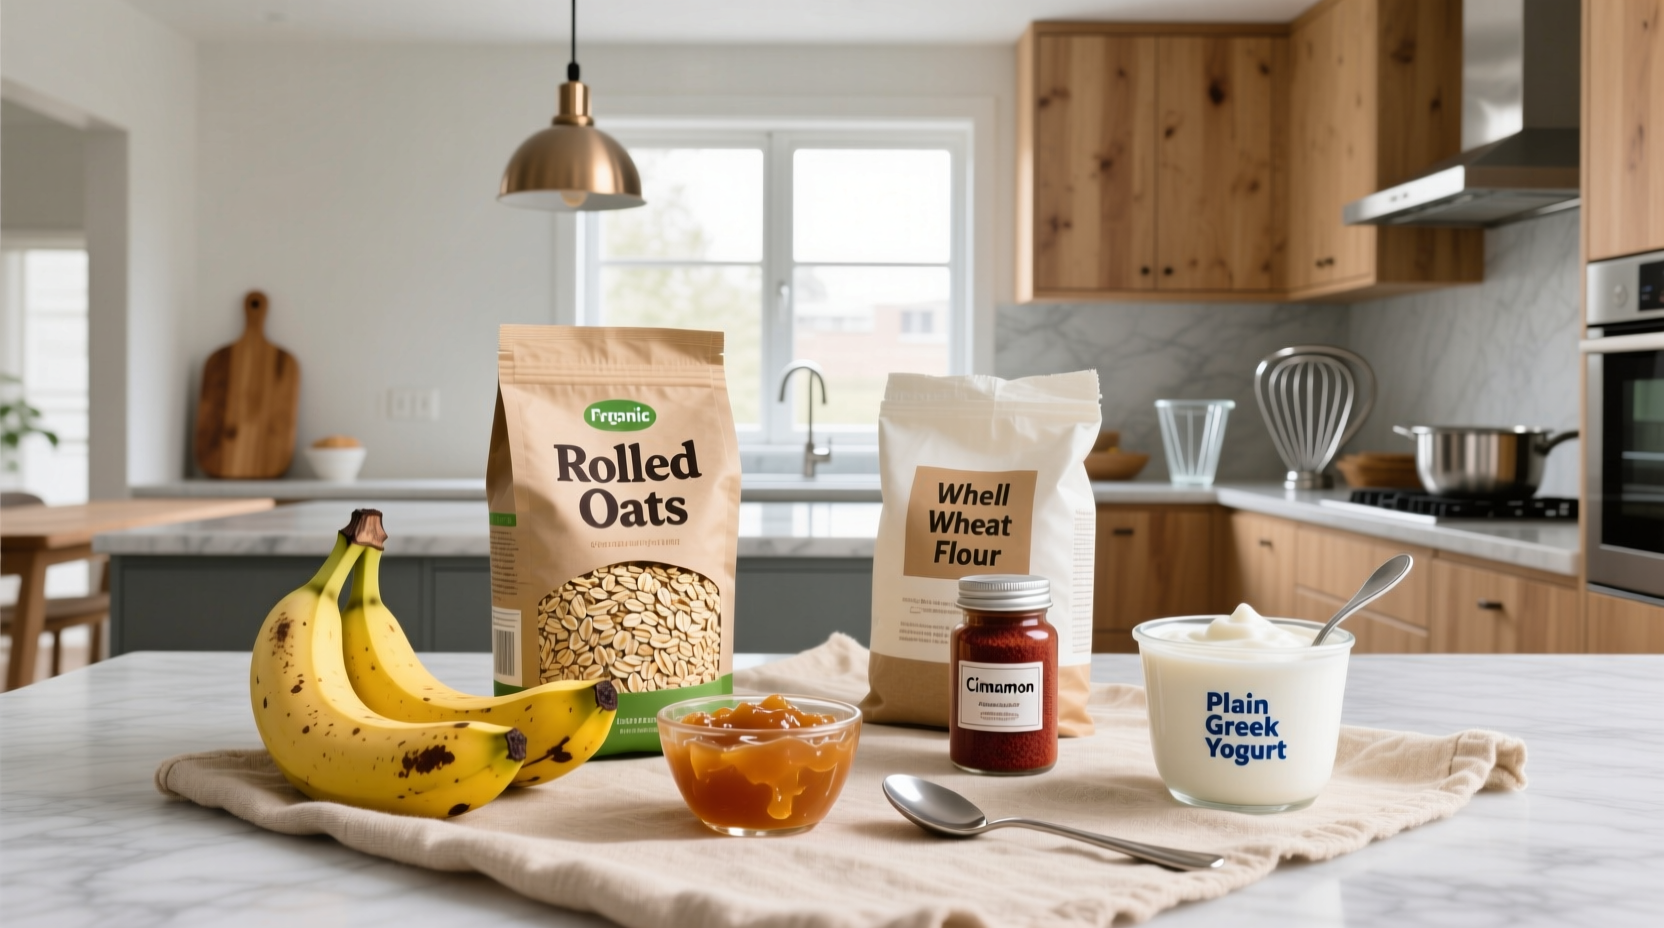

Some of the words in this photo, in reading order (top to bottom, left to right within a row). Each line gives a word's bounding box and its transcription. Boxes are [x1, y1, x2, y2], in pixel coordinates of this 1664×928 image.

[553, 439, 703, 484] Rolled
[938, 482, 1011, 506] Whell
[579, 488, 689, 529] Oats
[929, 510, 1012, 536] Wheat
[933, 540, 1002, 566] Flour
[1207, 692, 1268, 715] Plain
[1205, 714, 1279, 737] Greek
[1205, 737, 1287, 766] Yogurt
